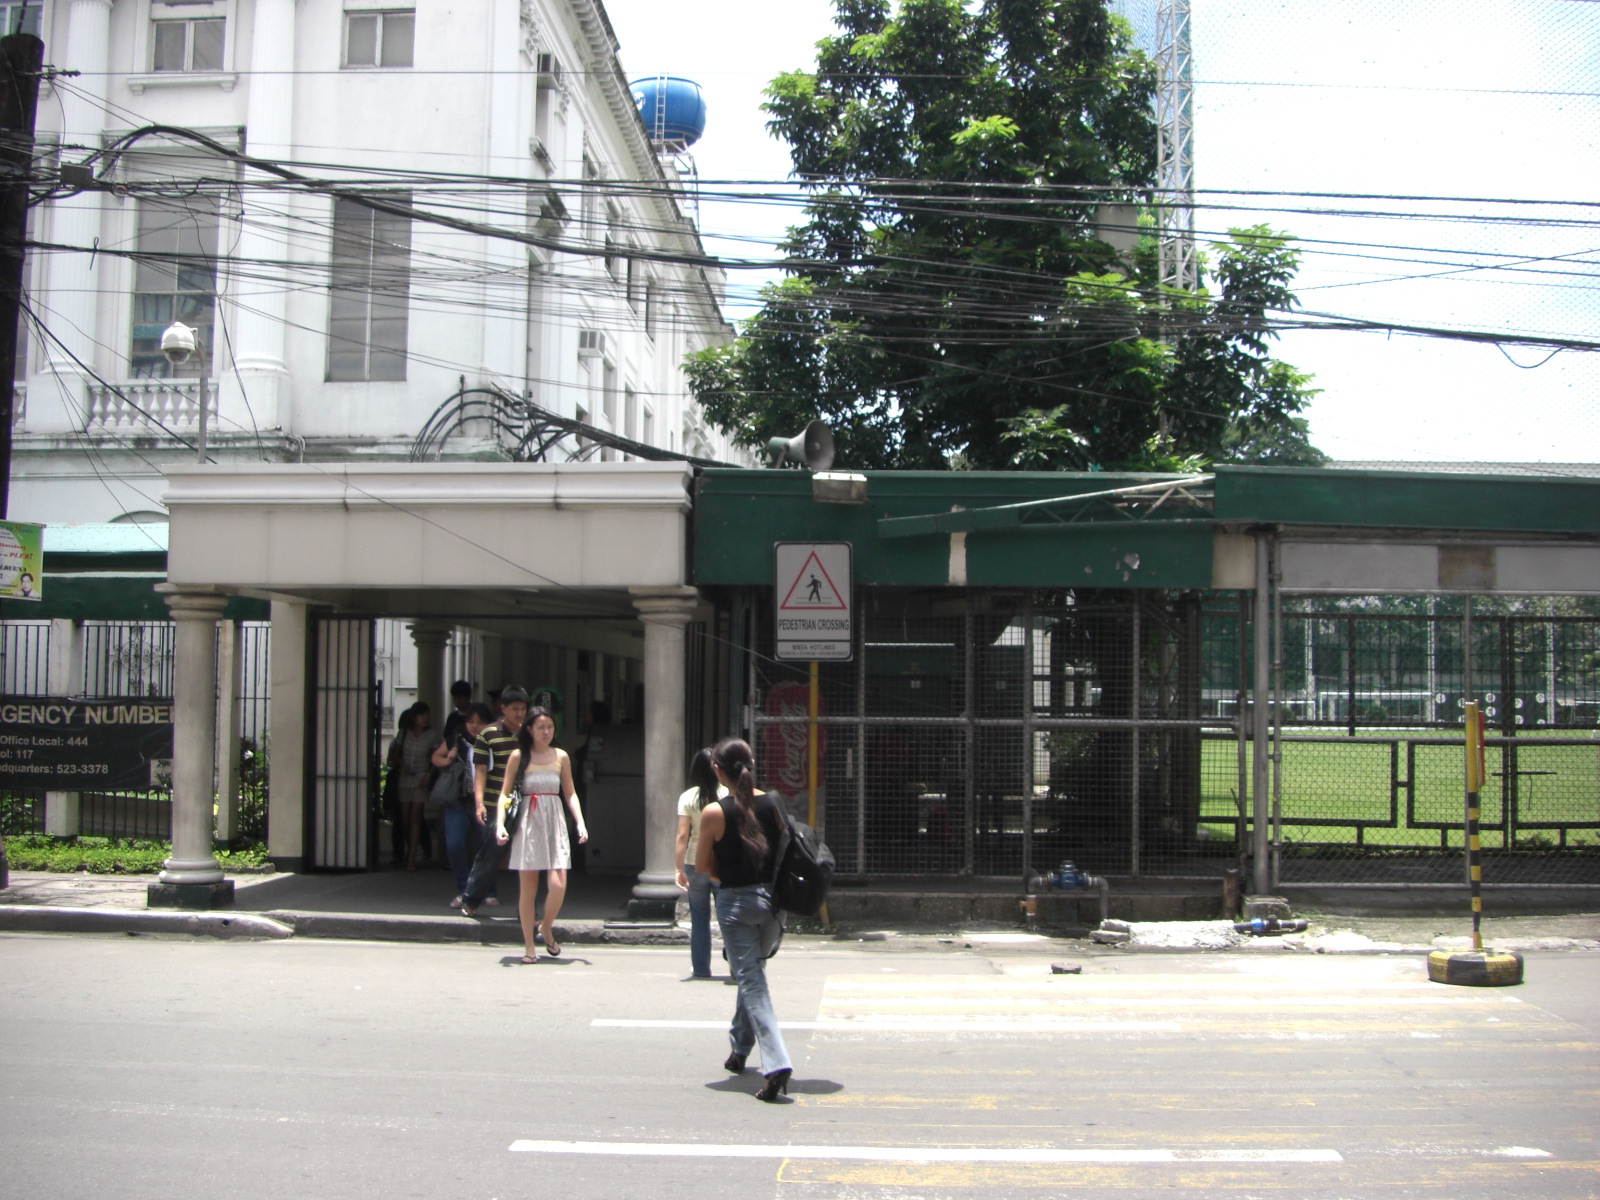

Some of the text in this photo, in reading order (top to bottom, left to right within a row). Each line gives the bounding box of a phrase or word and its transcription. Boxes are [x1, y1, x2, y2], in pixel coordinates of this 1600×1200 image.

[778, 619, 850, 631] PEDESTRIAN CROSSING
[0, 704, 77, 724] GENCY
[0, 735, 89, 746] Office Local: 444
[16, 750, 34, 759] 117
[0, 763, 109, 775] dquarters: 523-3378
